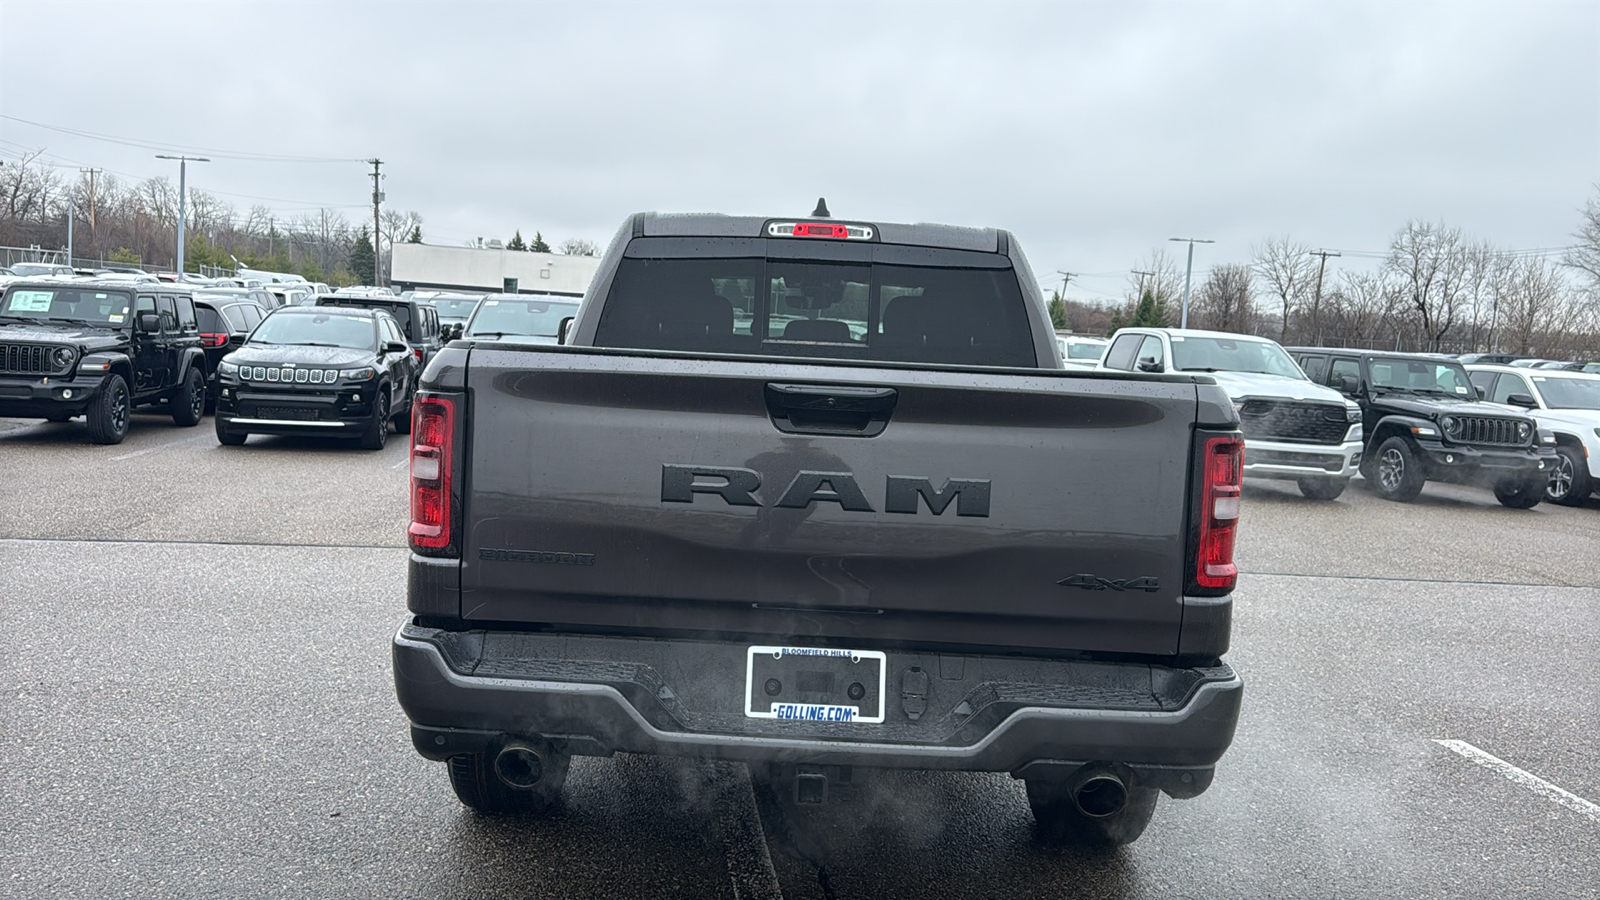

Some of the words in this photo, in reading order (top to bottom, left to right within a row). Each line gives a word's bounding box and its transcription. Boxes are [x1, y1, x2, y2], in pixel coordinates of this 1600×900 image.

[661, 463, 992, 517] RAM
[782, 647, 829, 656] BLOOMFIELD
[777, 705, 852, 722] GOLLING.COM
